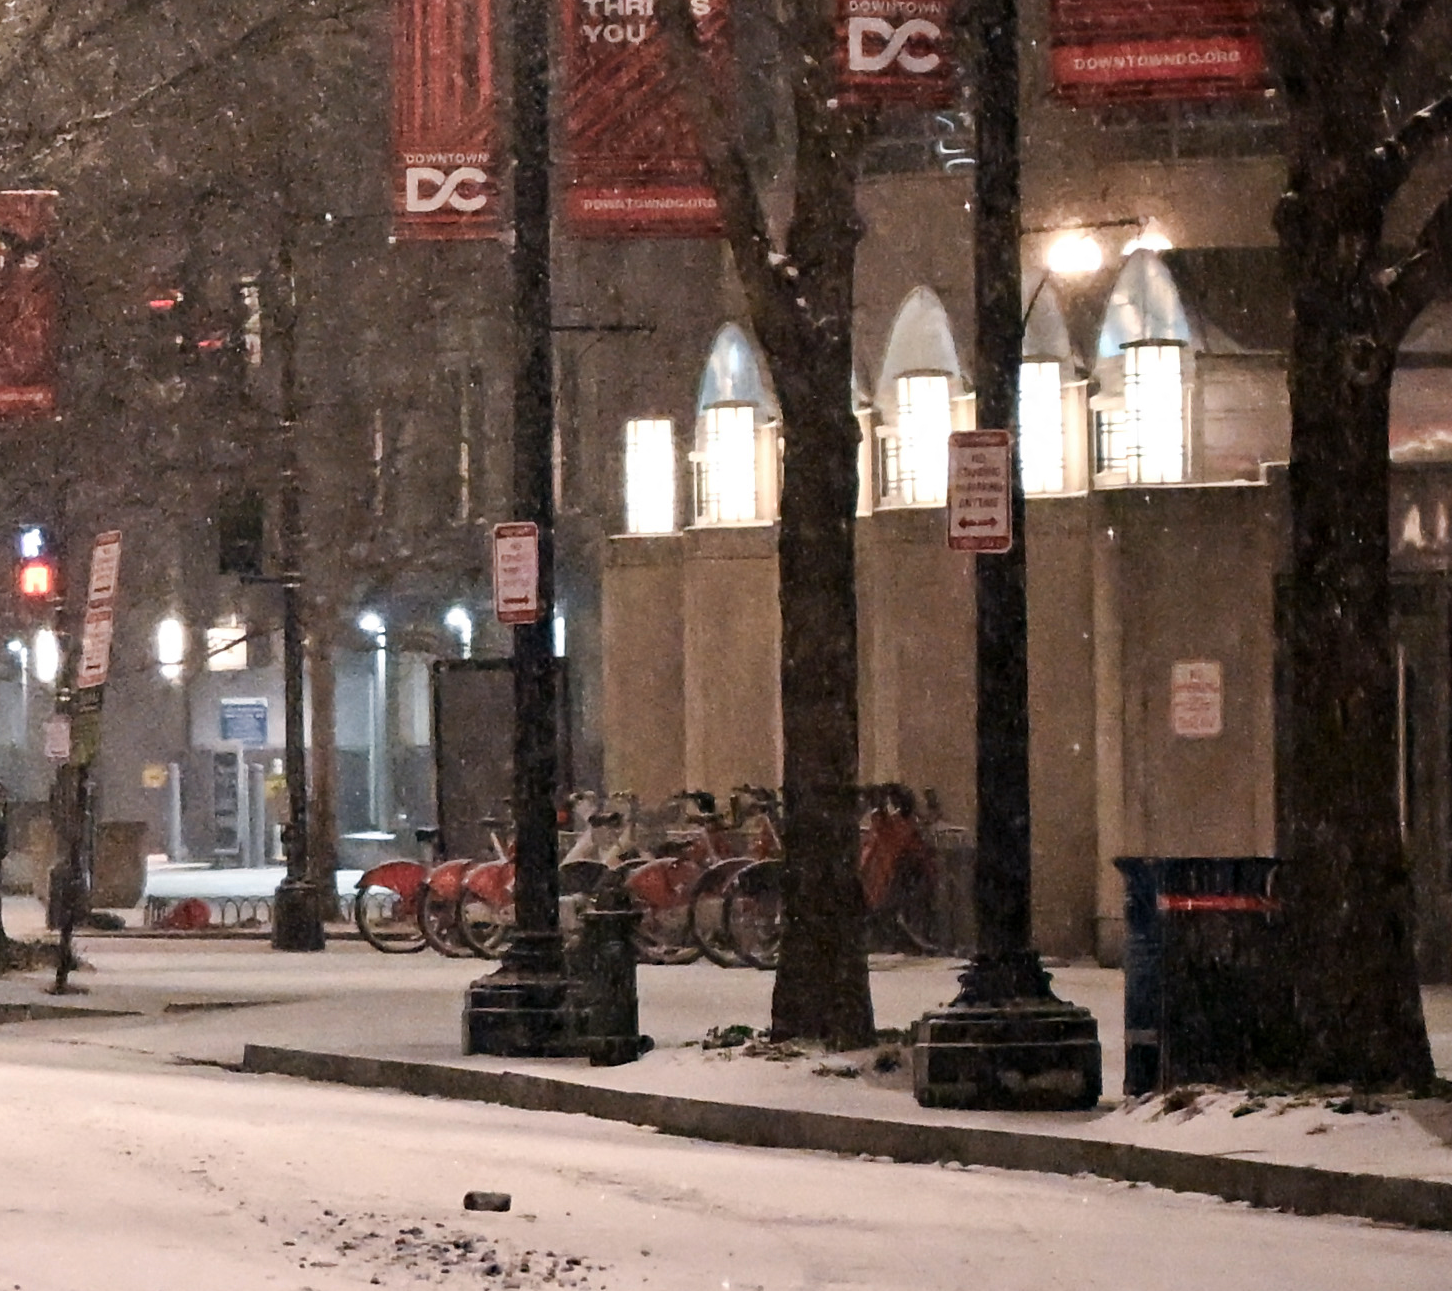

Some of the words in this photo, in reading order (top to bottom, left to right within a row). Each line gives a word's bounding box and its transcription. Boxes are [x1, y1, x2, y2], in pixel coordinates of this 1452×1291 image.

[849, 0, 941, 13] DOWNTOWN
[582, 23, 647, 45] YOU
[848, 16, 941, 73] DC
[1073, 49, 1241, 71] DOWNTOWNDC.ORG
[405, 152, 490, 164] DOWNTOWN
[406, 166, 488, 212] DC
